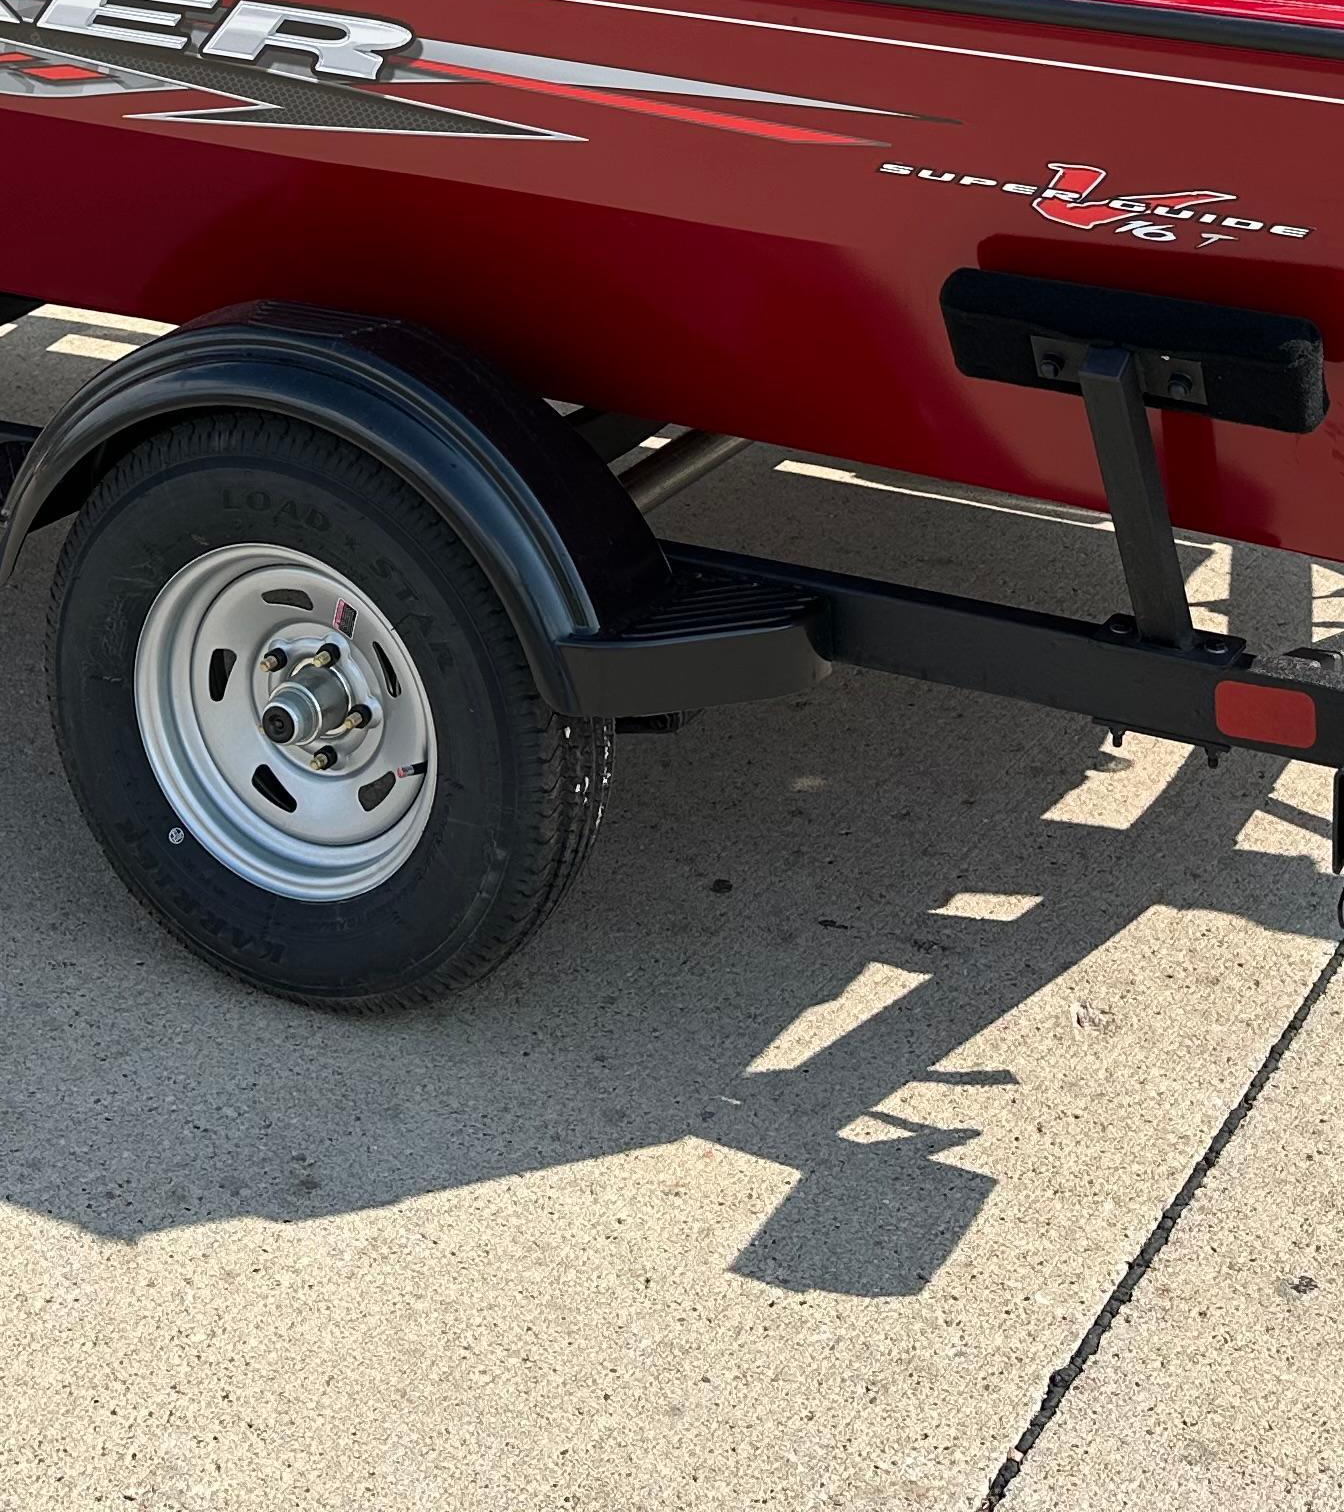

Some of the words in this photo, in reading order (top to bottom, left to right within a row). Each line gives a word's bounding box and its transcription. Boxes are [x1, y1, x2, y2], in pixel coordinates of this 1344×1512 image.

[878, 161, 1082, 203] SUPER
[1107, 198, 1311, 240] GUIDE
[1113, 220, 1177, 242] 16
[221, 487, 332, 532] LOAD
